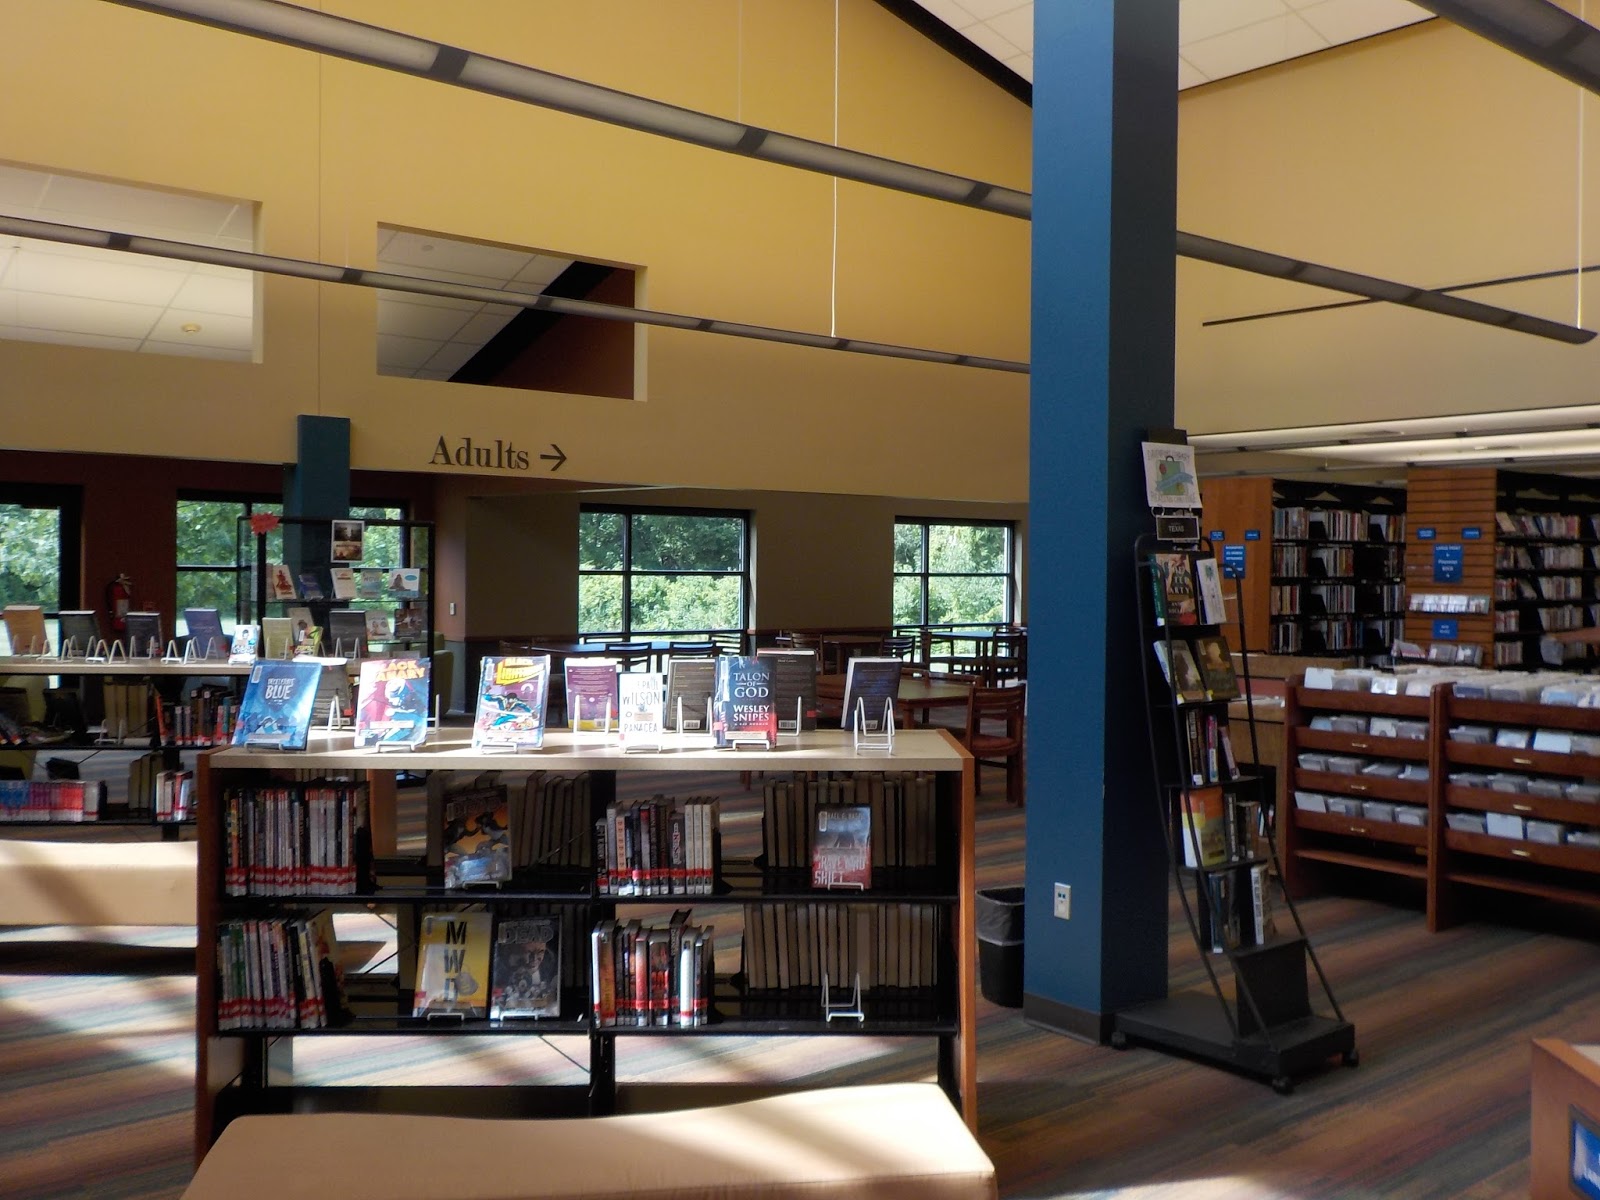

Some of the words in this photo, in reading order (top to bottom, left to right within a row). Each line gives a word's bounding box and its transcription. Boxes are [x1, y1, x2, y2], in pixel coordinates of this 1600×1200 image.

[428, 435, 529, 470] Adults
[733, 672, 770, 681] TALON
[265, 685, 293, 699] BLUE
[734, 687, 769, 698] GOD
[622, 691, 660, 706] WILSON
[733, 704, 770, 713] WESLEY
[733, 713, 770, 722] SNIPES
[624, 723, 658, 733] PANACEA
[498, 924, 555, 944] DEAD
